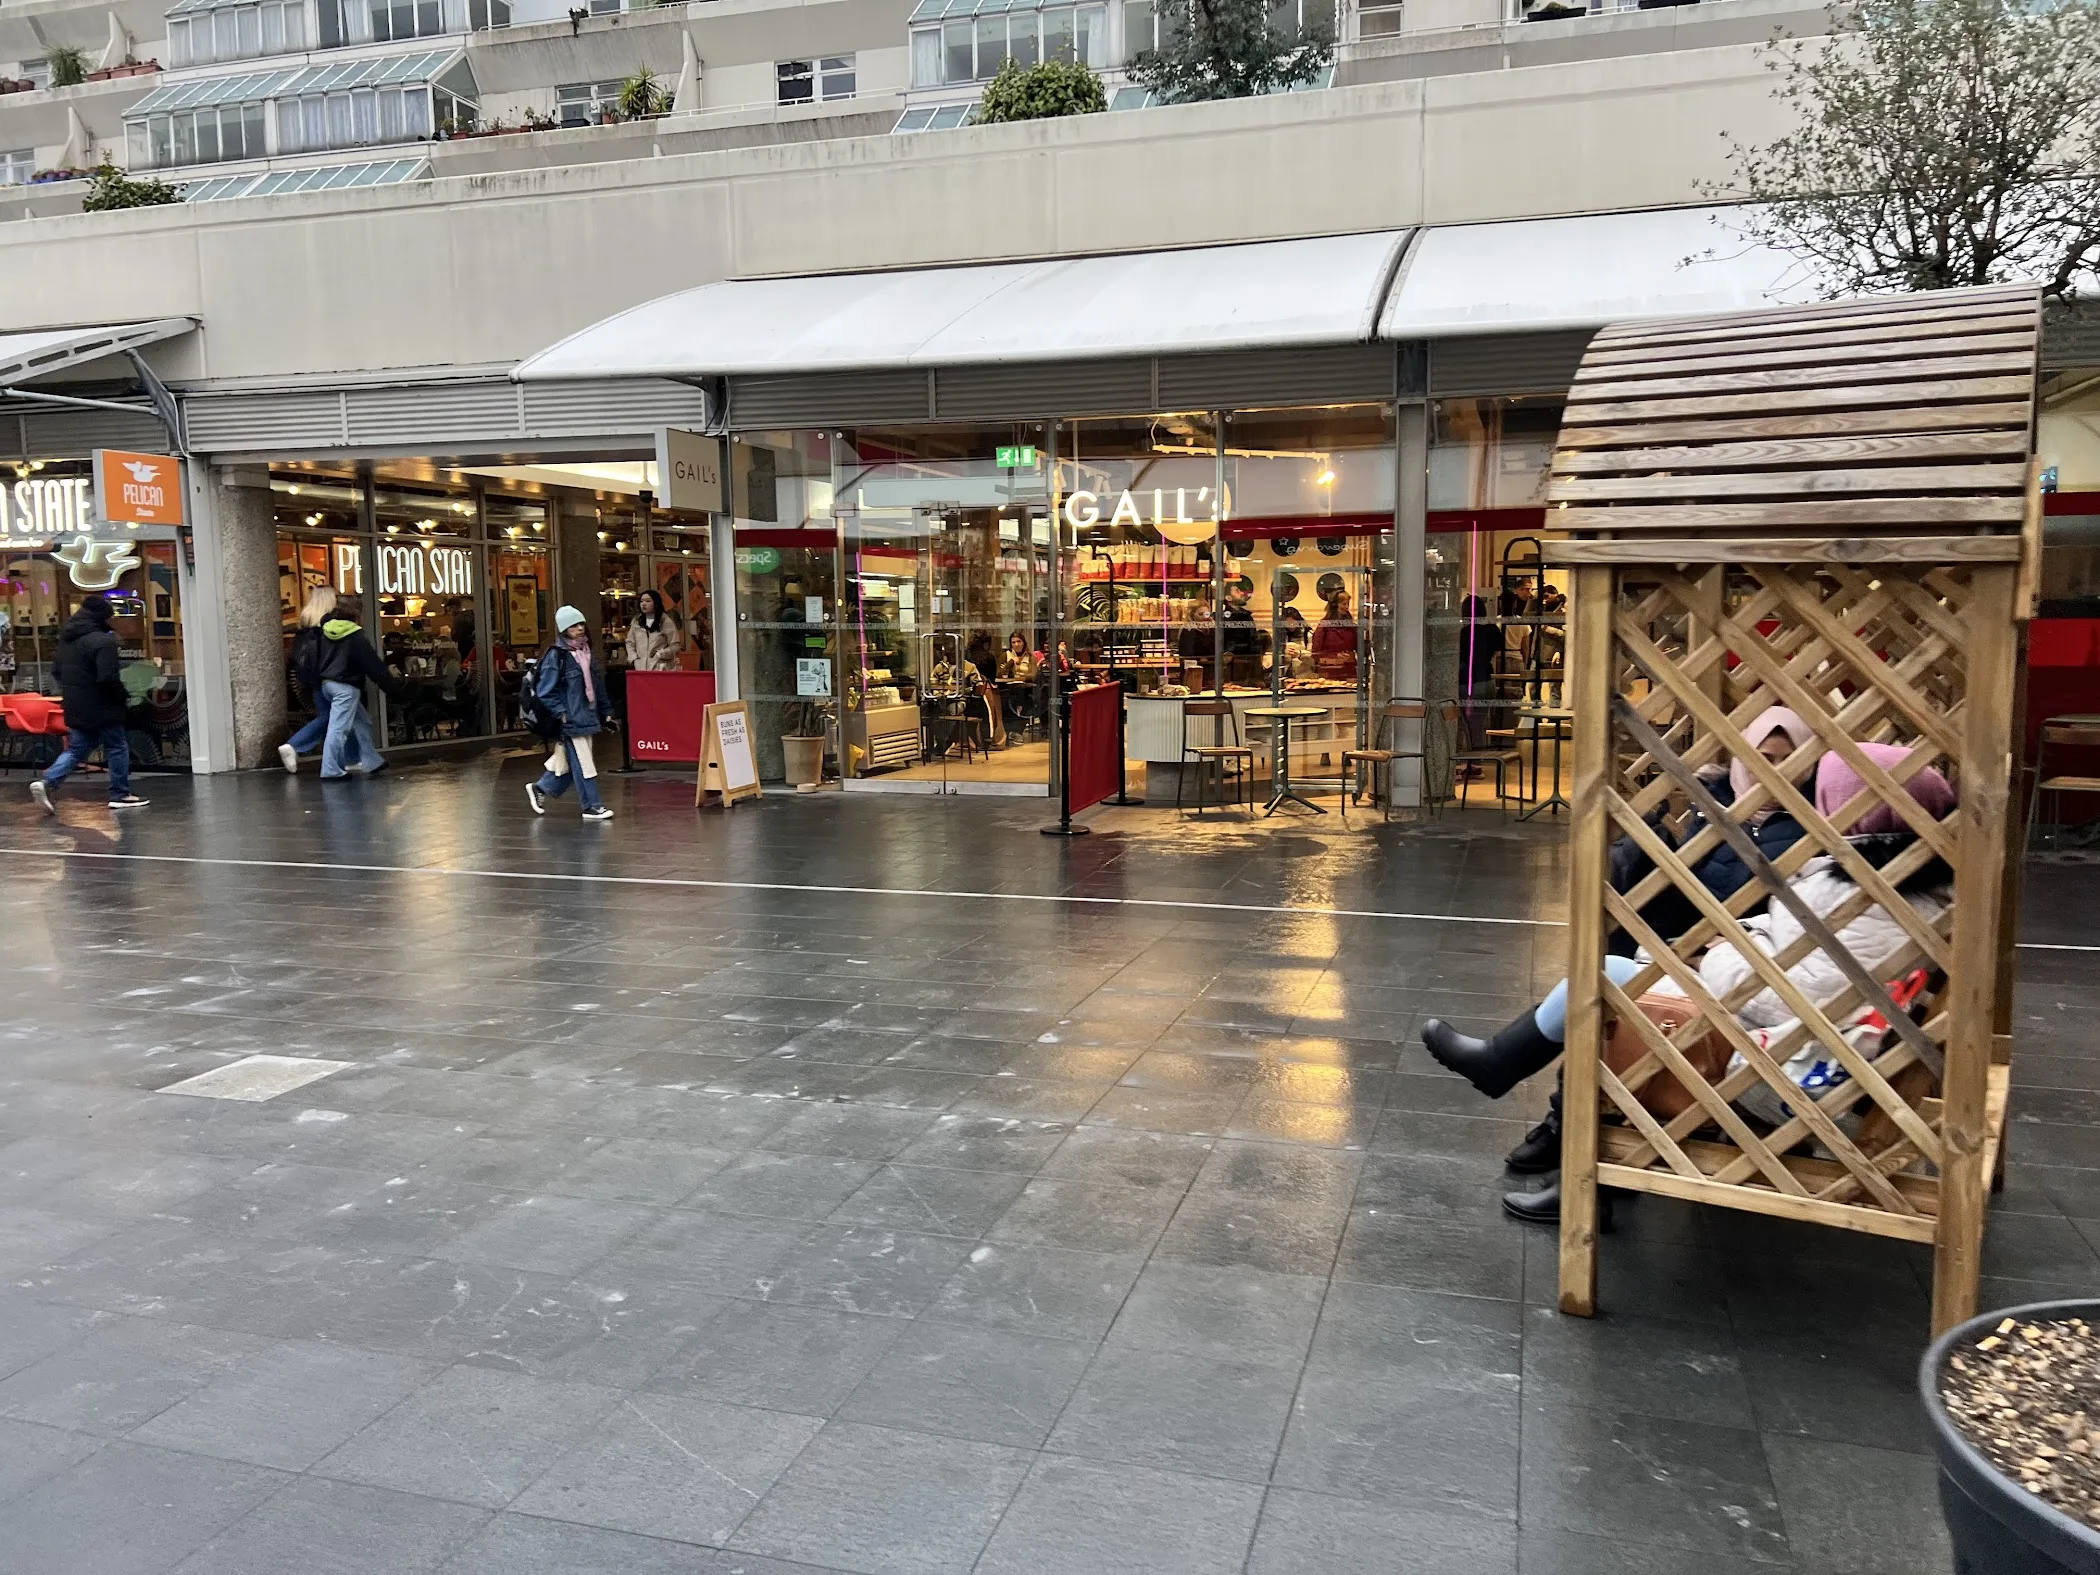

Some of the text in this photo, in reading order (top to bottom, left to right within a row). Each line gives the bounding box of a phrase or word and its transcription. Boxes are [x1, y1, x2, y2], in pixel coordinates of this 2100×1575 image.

[675, 460, 717, 485] GAIL's
[14, 478, 92, 533] STATE
[123, 483, 164, 507] PELICAN
[338, 545, 425, 594] PEICAN
[735, 718, 742, 726] AS
[738, 726, 745, 734] AS
[637, 740, 669, 751] GAIL's
